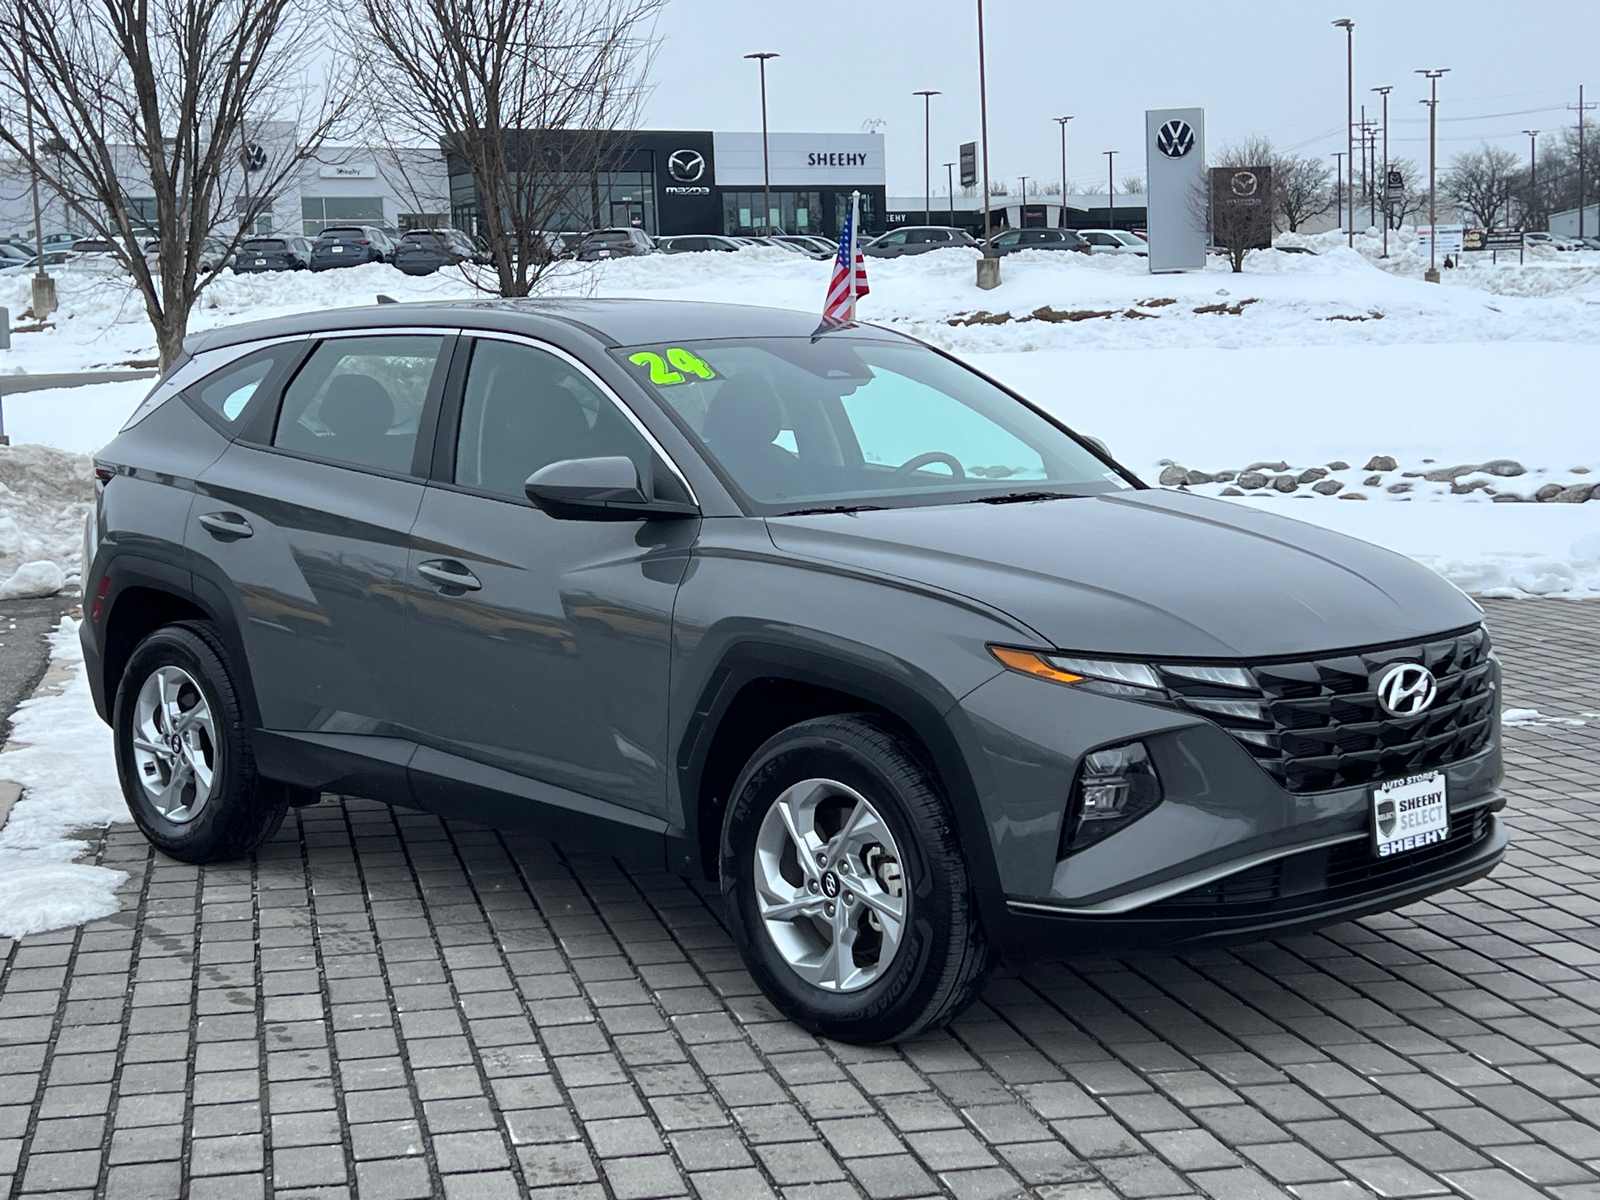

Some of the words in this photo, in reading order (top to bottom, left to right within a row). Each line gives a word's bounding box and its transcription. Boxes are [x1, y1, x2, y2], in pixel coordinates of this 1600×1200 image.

[808, 152, 867, 166] SHEEHY
[665, 186, 710, 196] mazda
[628, 347, 716, 385] 24
[1381, 779, 1406, 791] AUTO
[1406, 770, 1439, 786] STORES
[1399, 791, 1442, 813] SHEEHY
[1400, 805, 1443, 831] SELECT
[1379, 827, 1449, 857] SHEEHY
